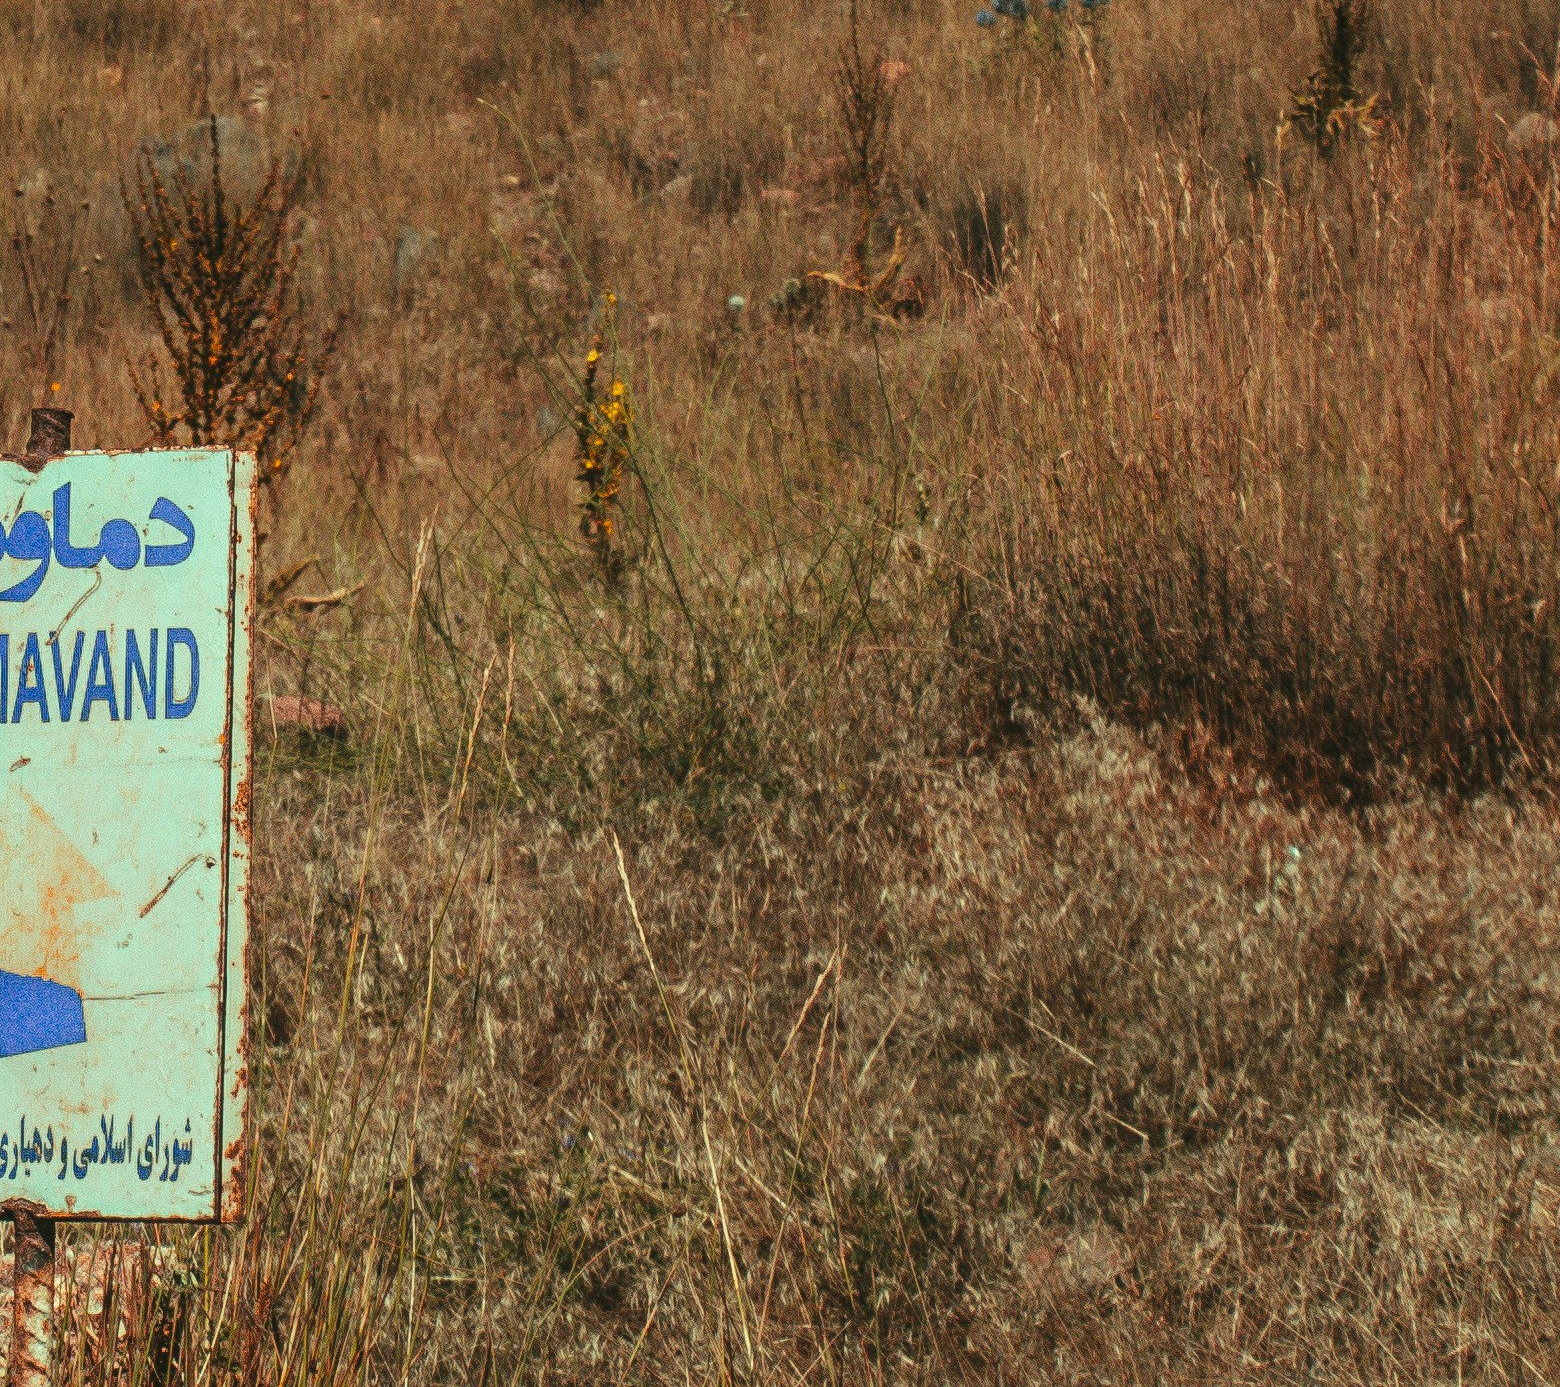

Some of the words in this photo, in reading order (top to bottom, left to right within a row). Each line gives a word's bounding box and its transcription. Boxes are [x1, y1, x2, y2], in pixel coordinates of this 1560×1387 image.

[57, 1136, 70, 1180] و
[73, 1113, 134, 1180] اسلامی
[136, 1114, 193, 1182] شورای
